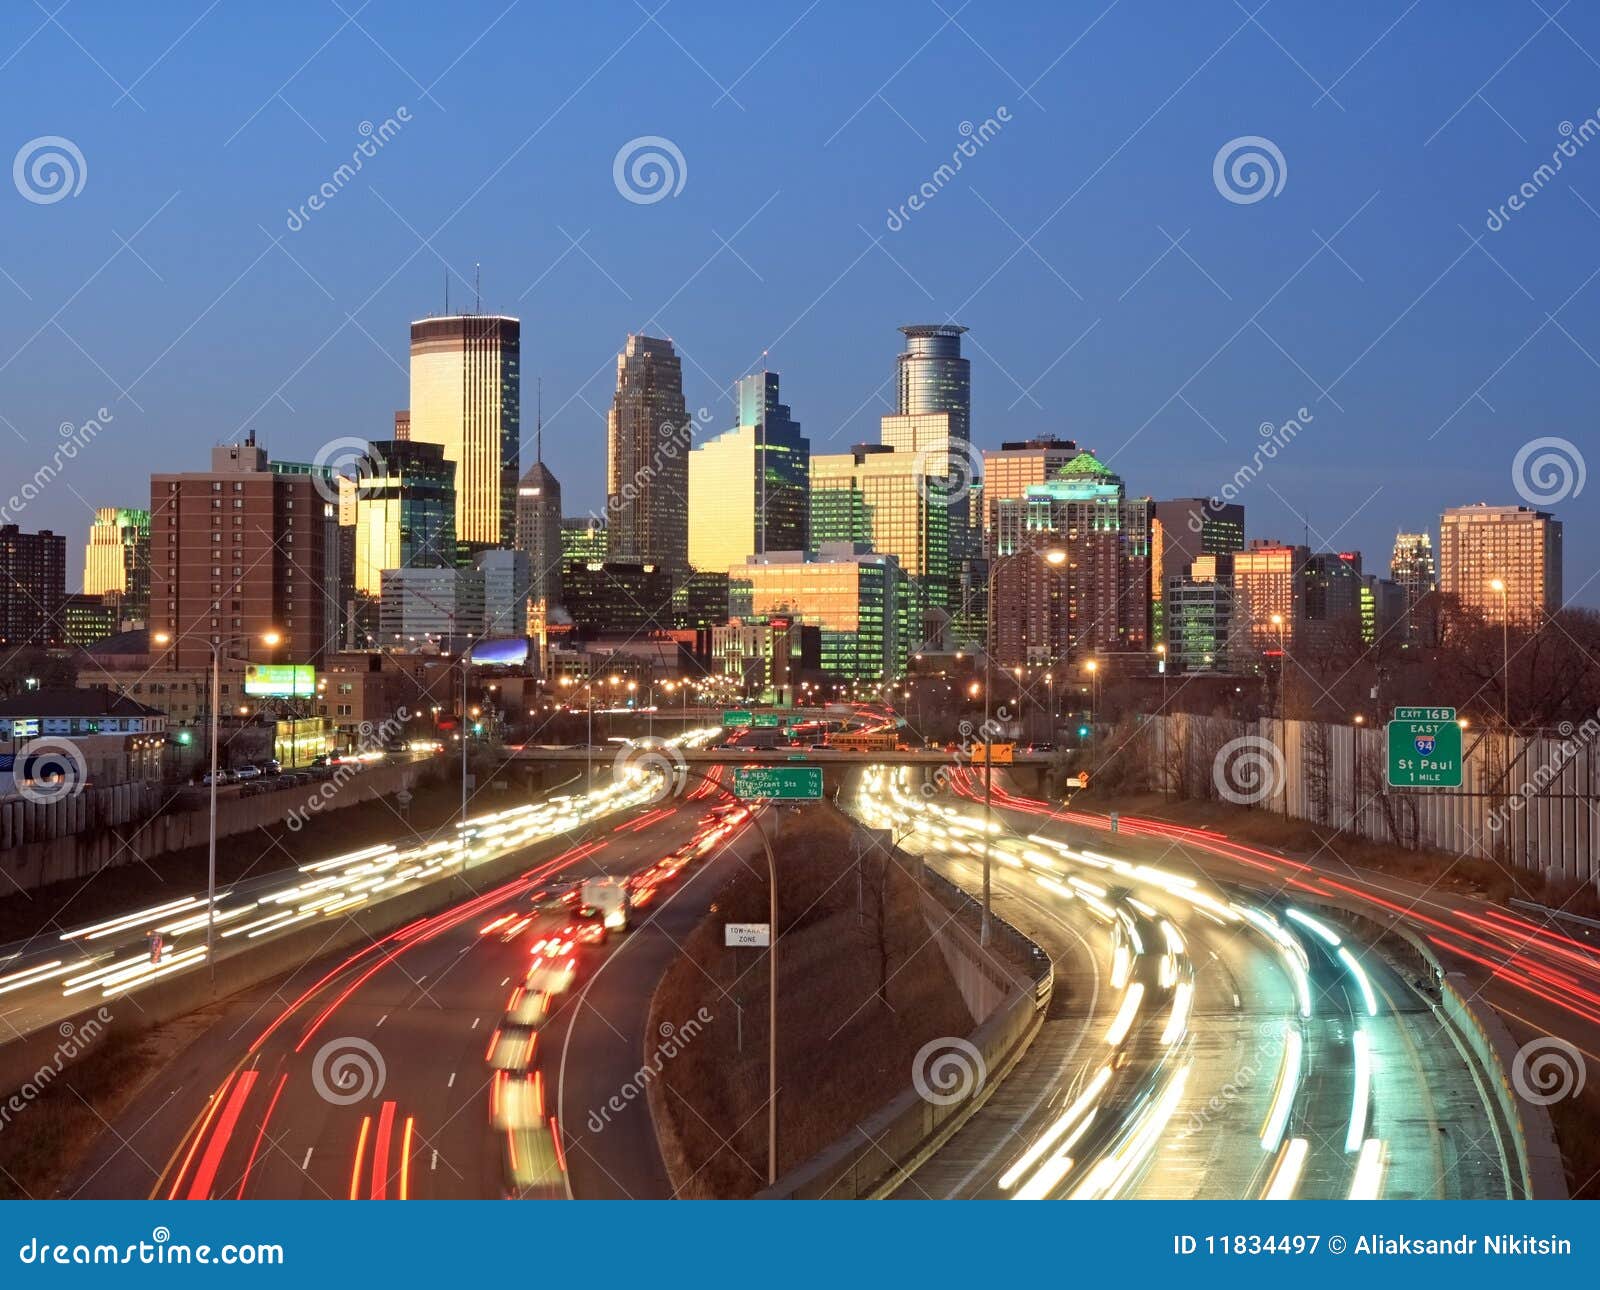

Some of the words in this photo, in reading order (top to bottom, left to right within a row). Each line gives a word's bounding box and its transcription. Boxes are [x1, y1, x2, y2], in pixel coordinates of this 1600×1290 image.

[1400, 710, 1421, 718] EXIT
[1426, 709, 1450, 720] 16B
[1410, 724, 1439, 733] EAST
[1417, 741, 1433, 751] 94
[1398, 759, 1414, 770] St
[1421, 759, 1453, 770] Paul
[1409, 773, 1415, 782] 1
